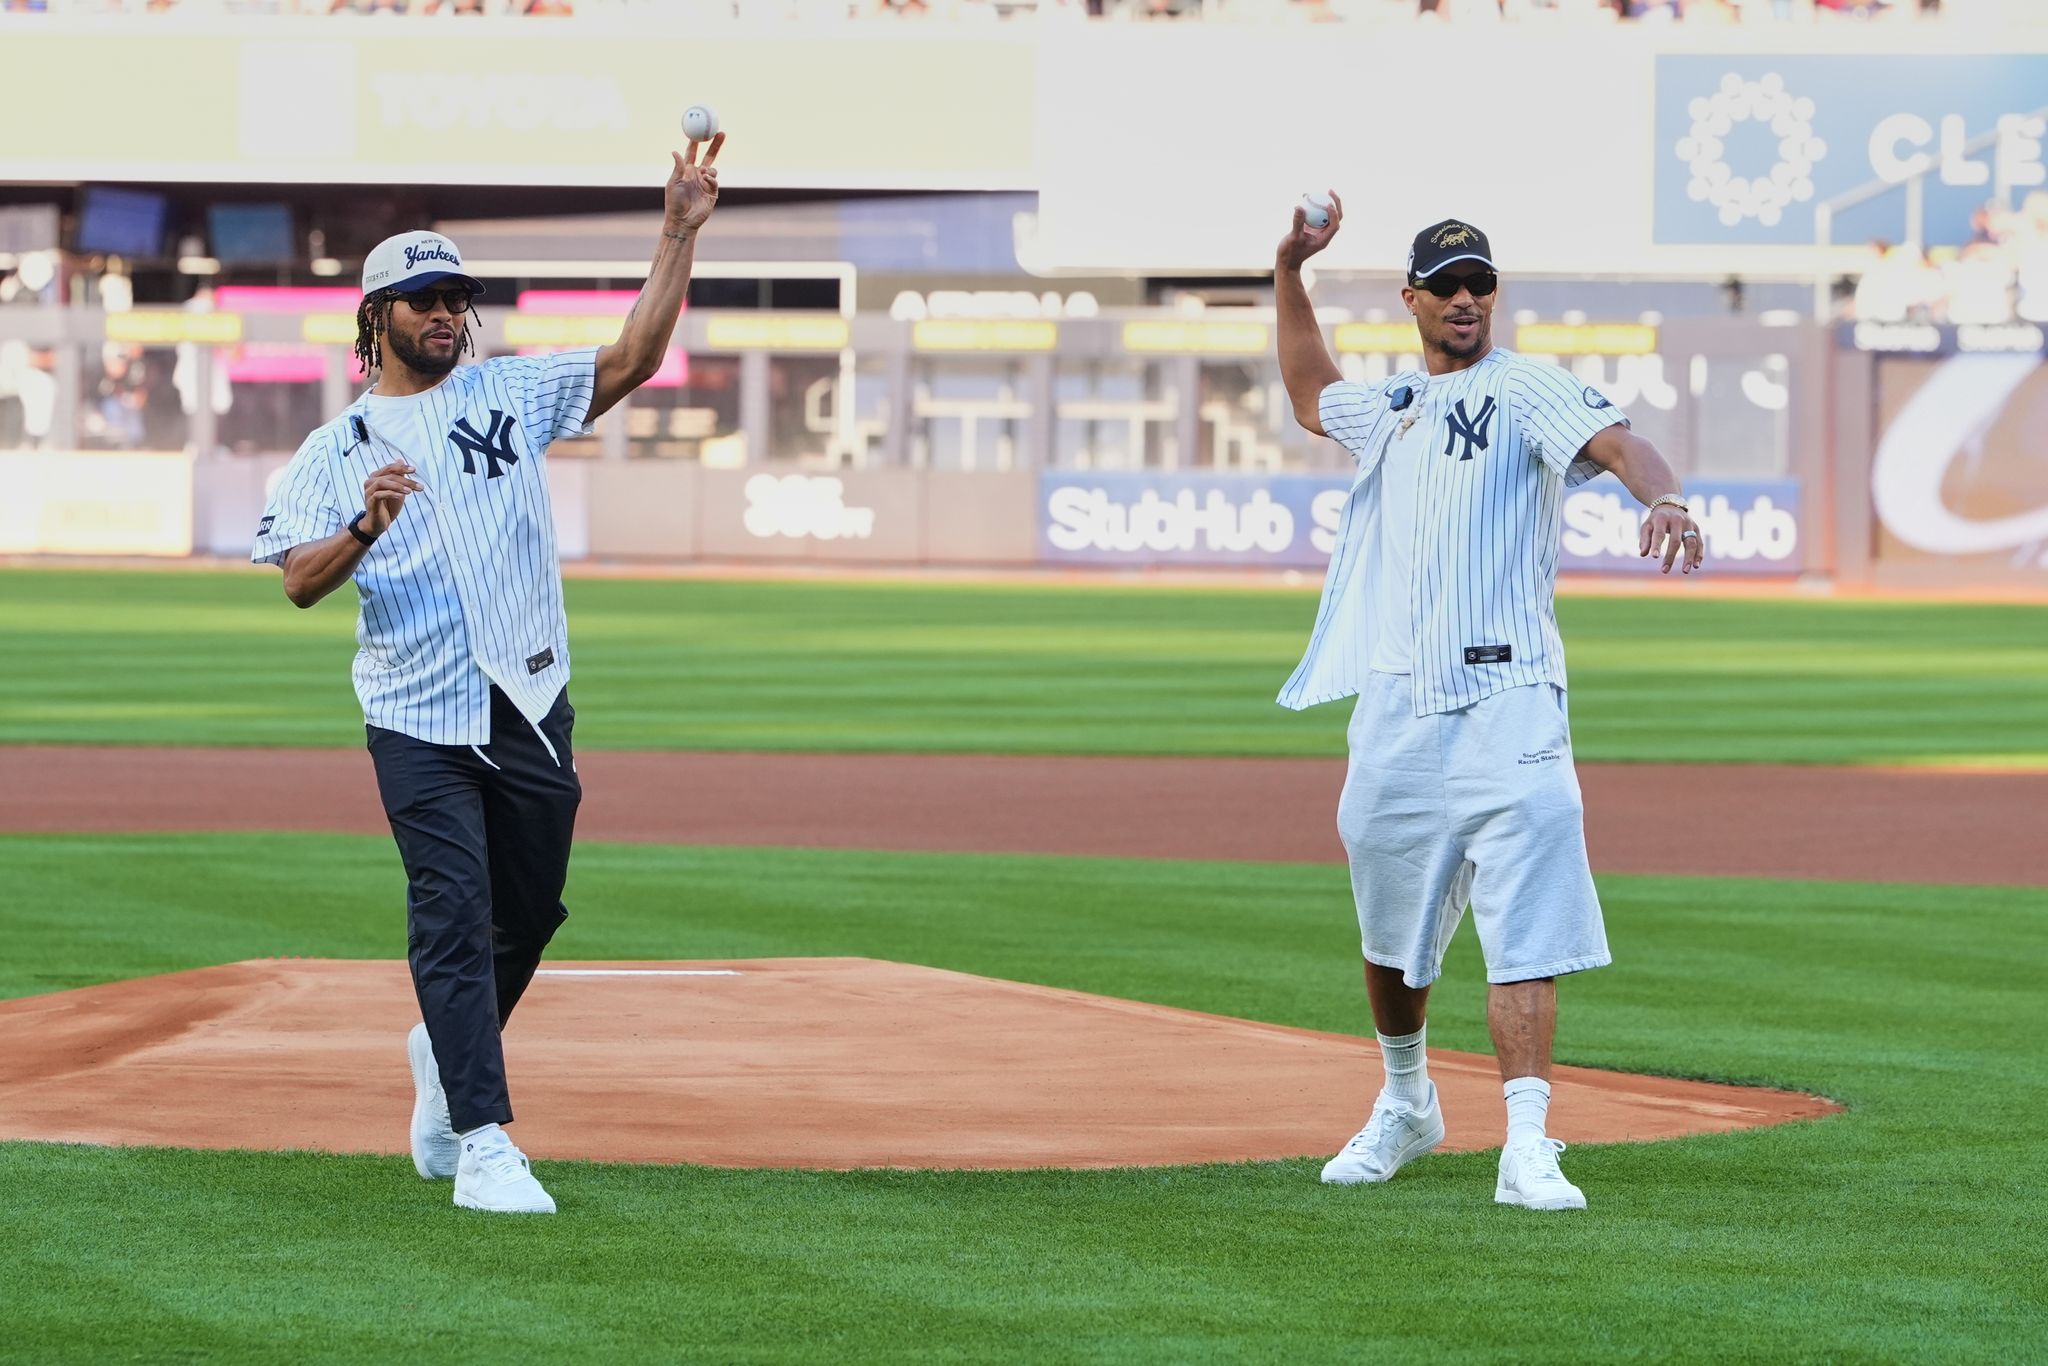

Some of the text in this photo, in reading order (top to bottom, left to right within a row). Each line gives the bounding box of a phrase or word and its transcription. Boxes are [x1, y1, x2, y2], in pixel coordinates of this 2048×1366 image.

[404, 244, 460, 270] Yankees
[447, 409, 519, 480] NY
[1444, 394, 1497, 462] NY
[1047, 486, 1294, 552] StubHub
[1561, 491, 1798, 560] StuHub
